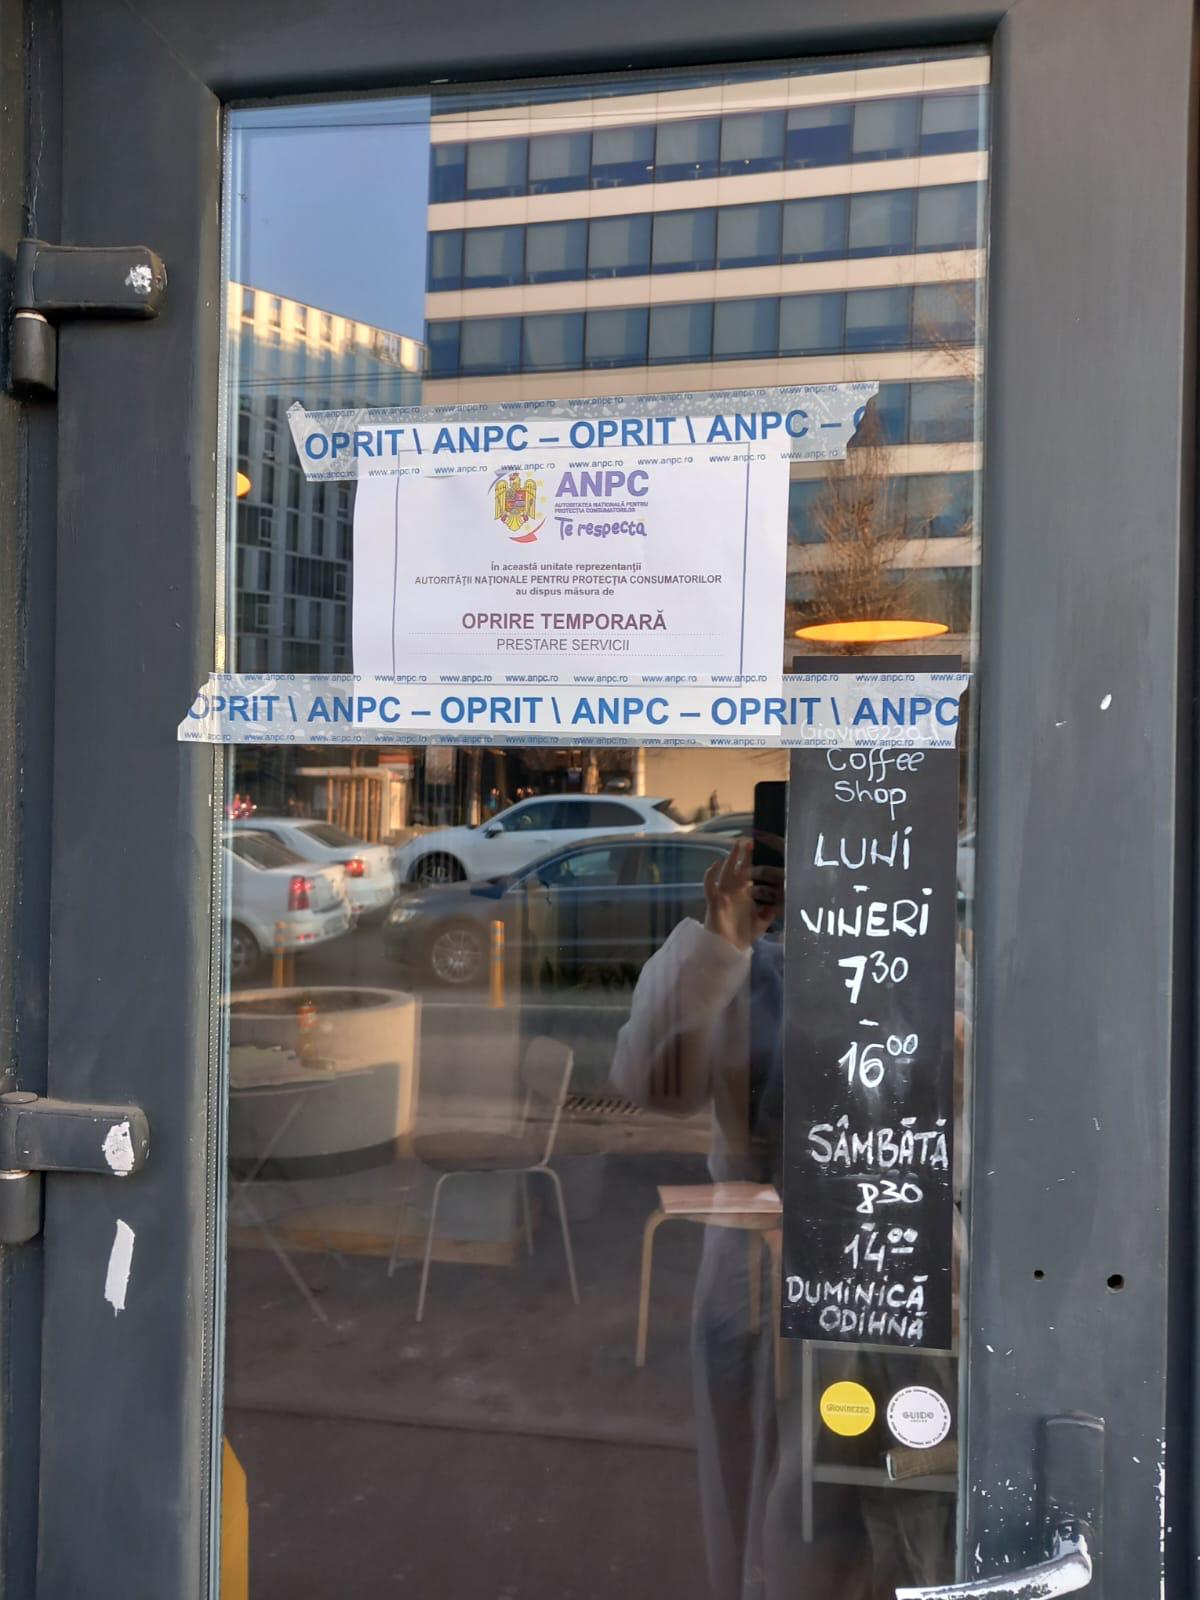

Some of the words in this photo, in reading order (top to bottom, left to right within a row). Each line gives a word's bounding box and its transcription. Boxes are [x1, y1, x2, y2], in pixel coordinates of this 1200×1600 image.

[304, 429, 405, 460] OPRIT
[432, 424, 528, 454] ANPC
[569, 417, 676, 448] OPRIT
[706, 409, 809, 443] ANPC
[555, 470, 649, 498] ANPC
[554, 516, 574, 540] Te
[491, 560, 500, 571] În
[503, 561, 538, 571] această
[540, 562, 573, 571] unitate
[531, 575, 570, 584] PENTRU
[629, 574, 722, 585] CONSUMATORILOR
[515, 588, 527, 596] au
[529, 587, 562, 597] dispus
[564, 587, 600, 596] măsura
[602, 587, 615, 596] de
[462, 612, 534, 630] OPRIRE
[541, 609, 667, 630] TEMPORARĂ
[496, 638, 568, 651] PRESTARE
[571, 639, 630, 651] SERVICII
[310, 674, 362, 682] www.anpc.ro
[374, 674, 427, 682] www.anpc.ro
[439, 674, 492, 683] www.anpc.ro
[504, 674, 559, 683] www.anpc.ro
[573, 674, 629, 683] www.anpc.ro
[641, 674, 698, 683] www.anpc.ro
[711, 673, 768, 683] www.anpc.ro
[781, 673, 839, 683] www.anpc.ro
[855, 673, 916, 683] www.anpc.ro
[188, 692, 280, 722] OPRIT
[307, 696, 401, 723] ANPC
[440, 696, 544, 724] OPRIT
[571, 697, 670, 725] ANPC
[711, 697, 822, 726] OPRIT
[851, 696, 960, 726] ANPC
[827, 748, 925, 783] Coffee
[834, 780, 907, 821] Shop
